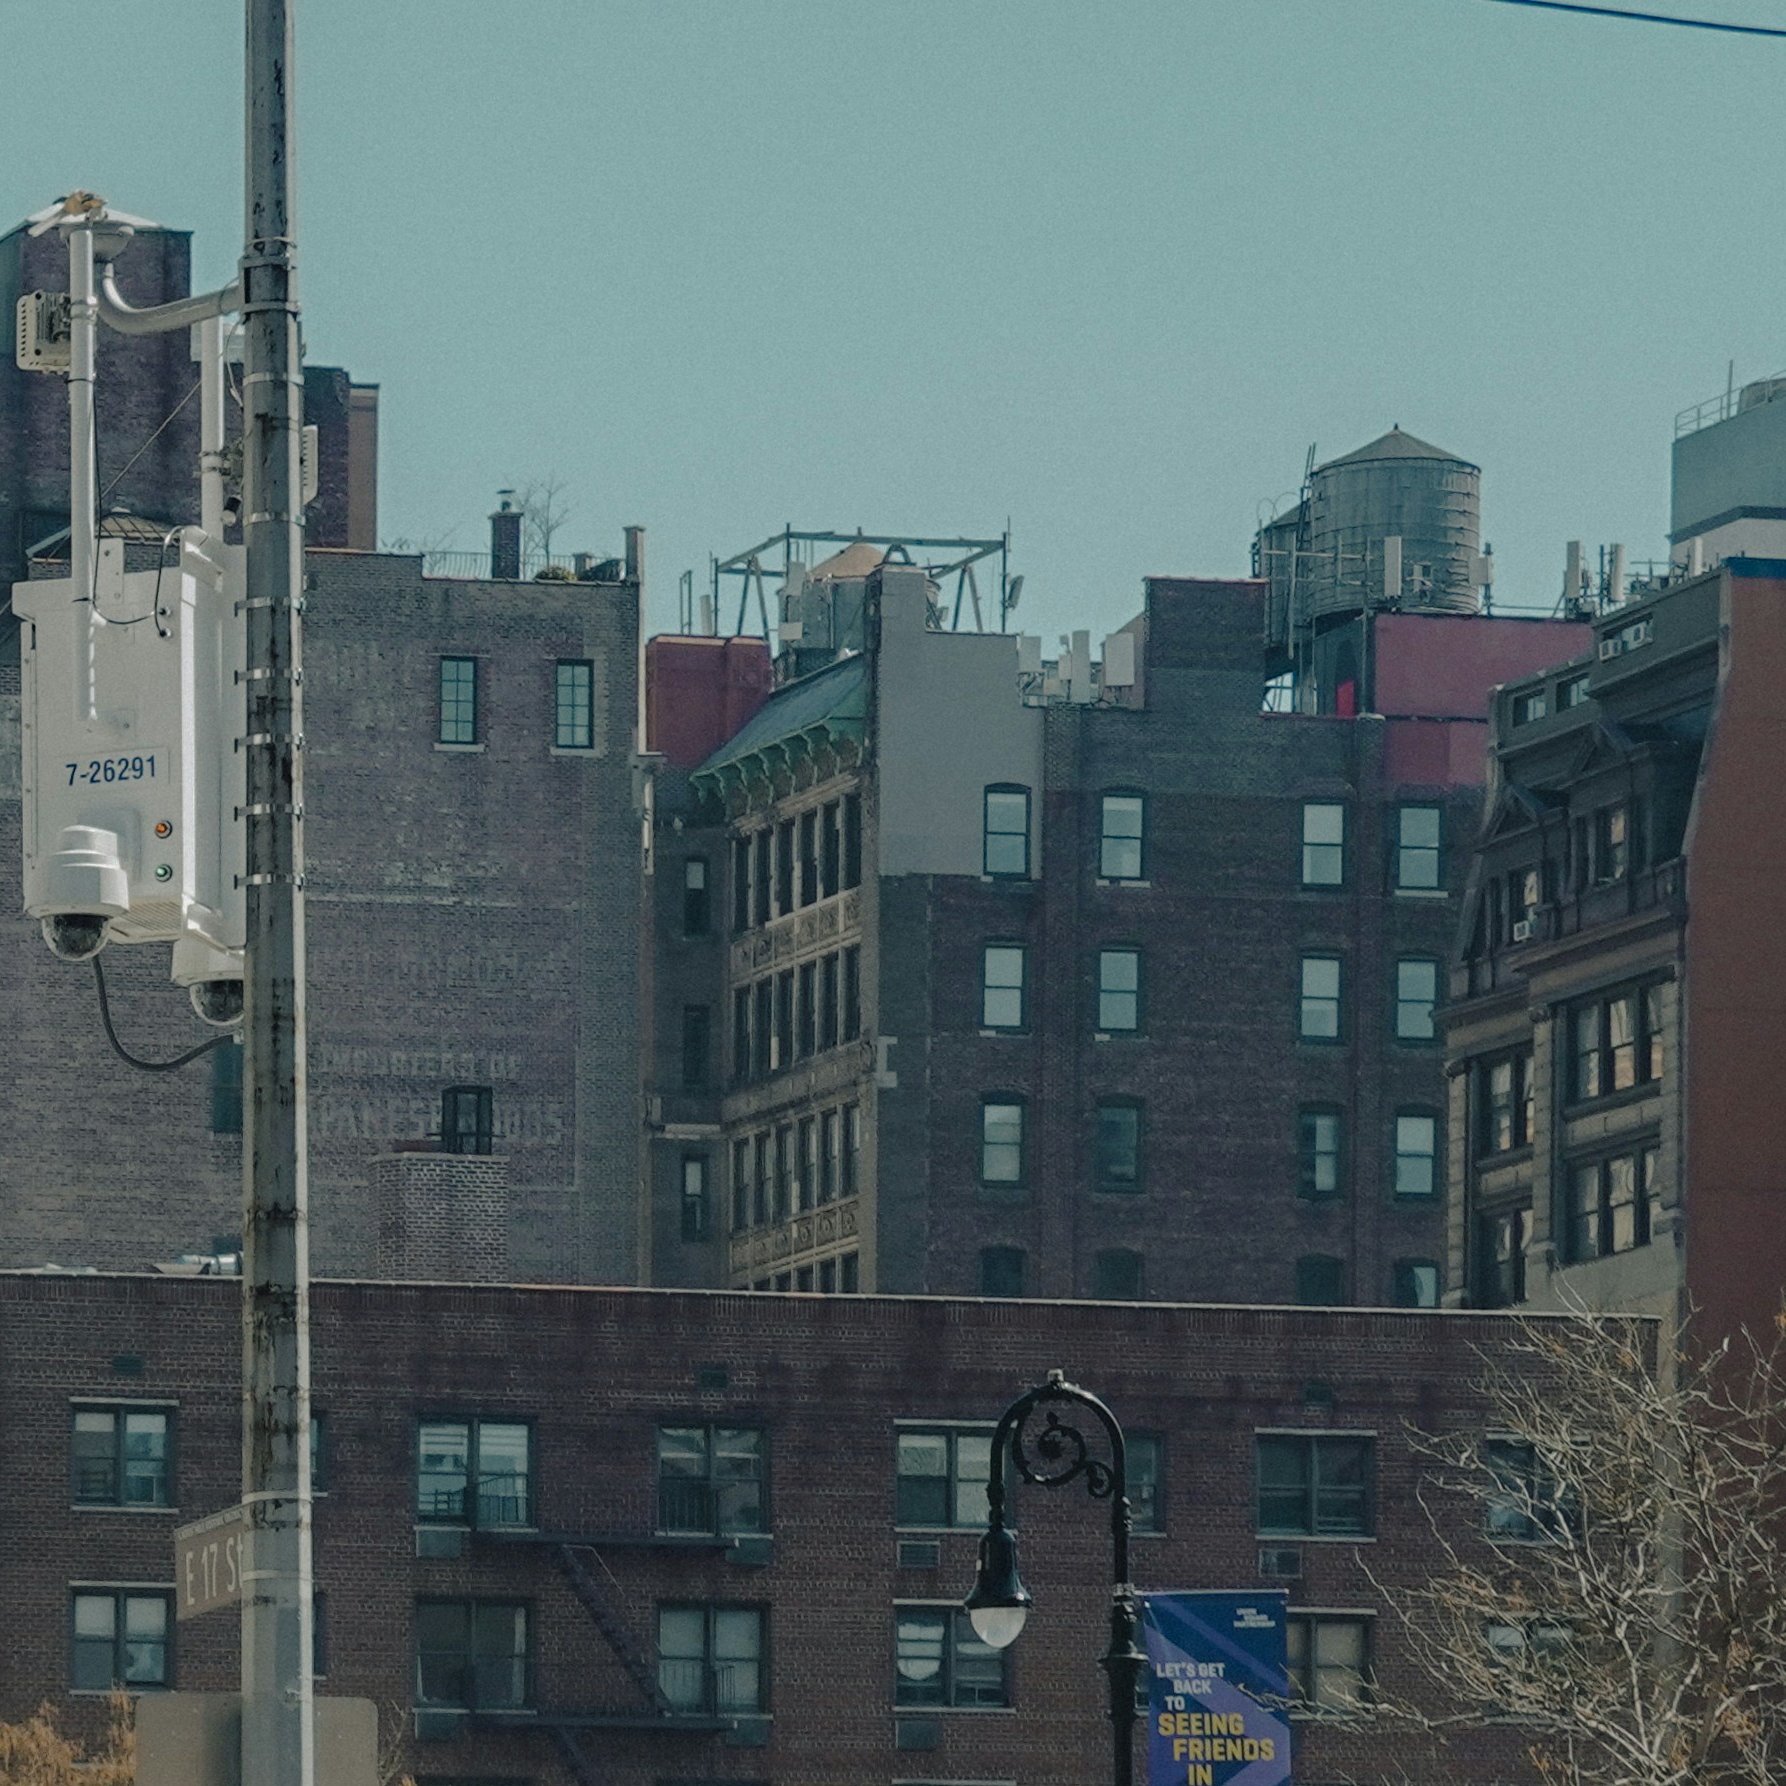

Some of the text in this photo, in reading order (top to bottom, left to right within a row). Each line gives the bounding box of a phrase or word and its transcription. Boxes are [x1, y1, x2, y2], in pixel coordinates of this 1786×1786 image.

[65, 754, 156, 786] 7-26291
[186, 1532, 244, 1606] E 17 St
[1156, 1663, 1225, 1679] LET'S GET
[1173, 1680, 1212, 1695] BACK
[1165, 1696, 1186, 1711] TO
[1158, 1713, 1245, 1736] SEEING
[1173, 1739, 1275, 1761] FRIENDS
[1188, 1765, 1213, 1786] IN
